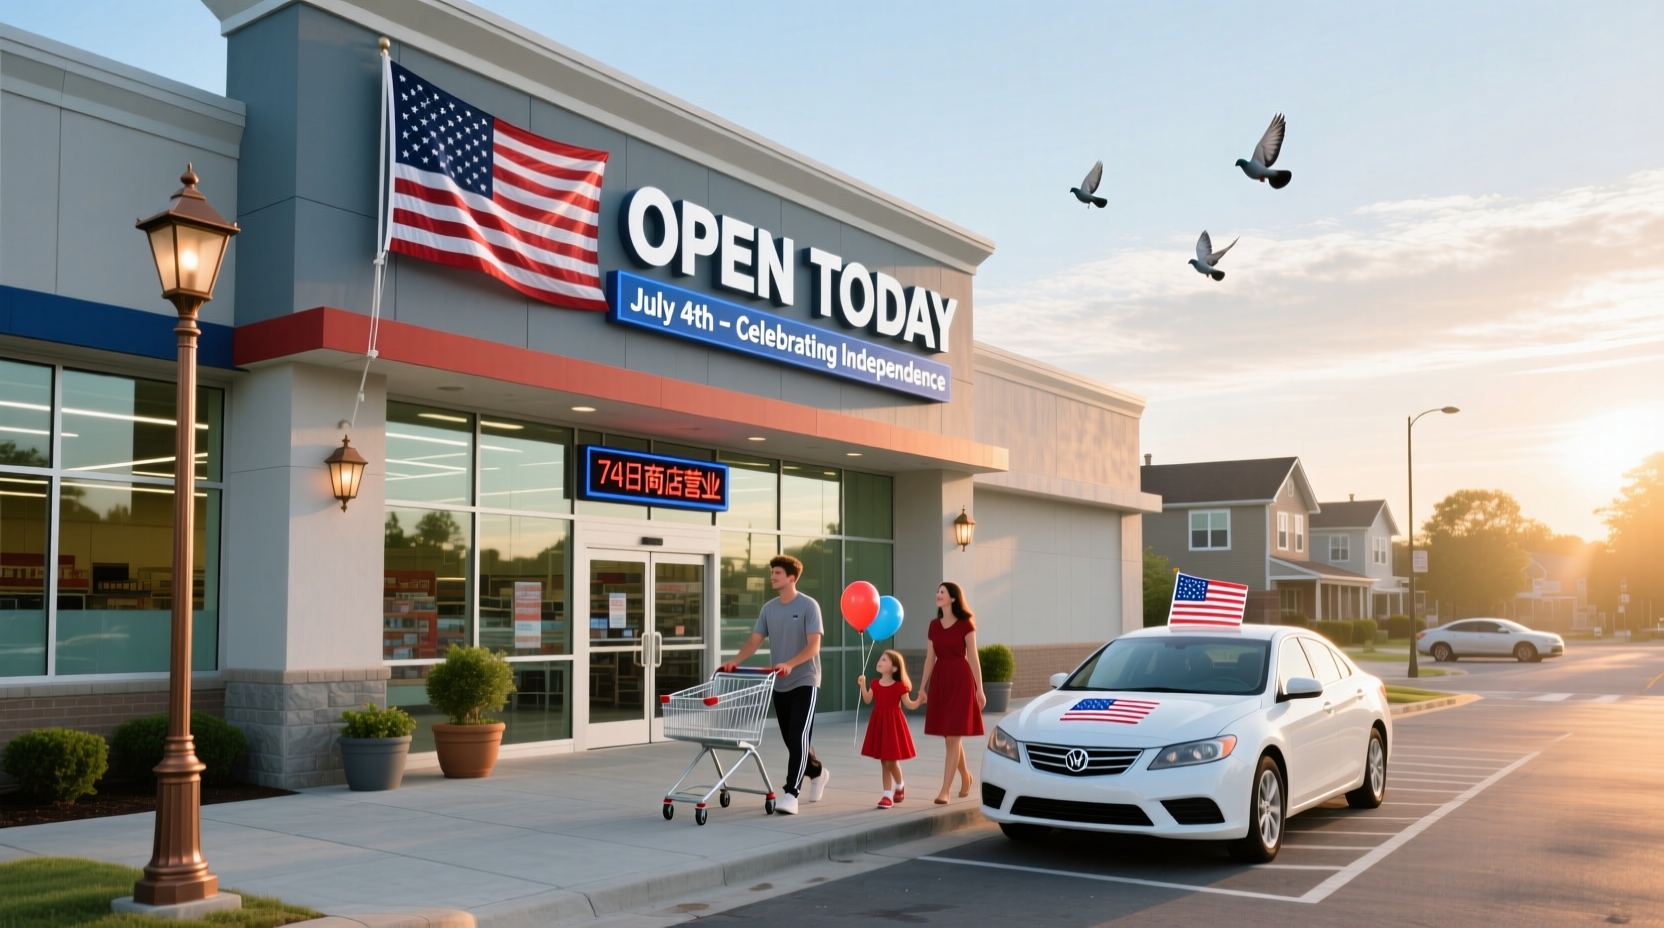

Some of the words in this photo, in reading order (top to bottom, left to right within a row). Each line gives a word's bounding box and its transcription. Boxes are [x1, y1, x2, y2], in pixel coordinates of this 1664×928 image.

[626, 186, 795, 306] OPEN
[809, 247, 958, 353] TODAY
[630, 287, 676, 326] July
[680, 301, 714, 332] 4th
[736, 315, 837, 369] Celebrating
[842, 342, 946, 391] Independence
